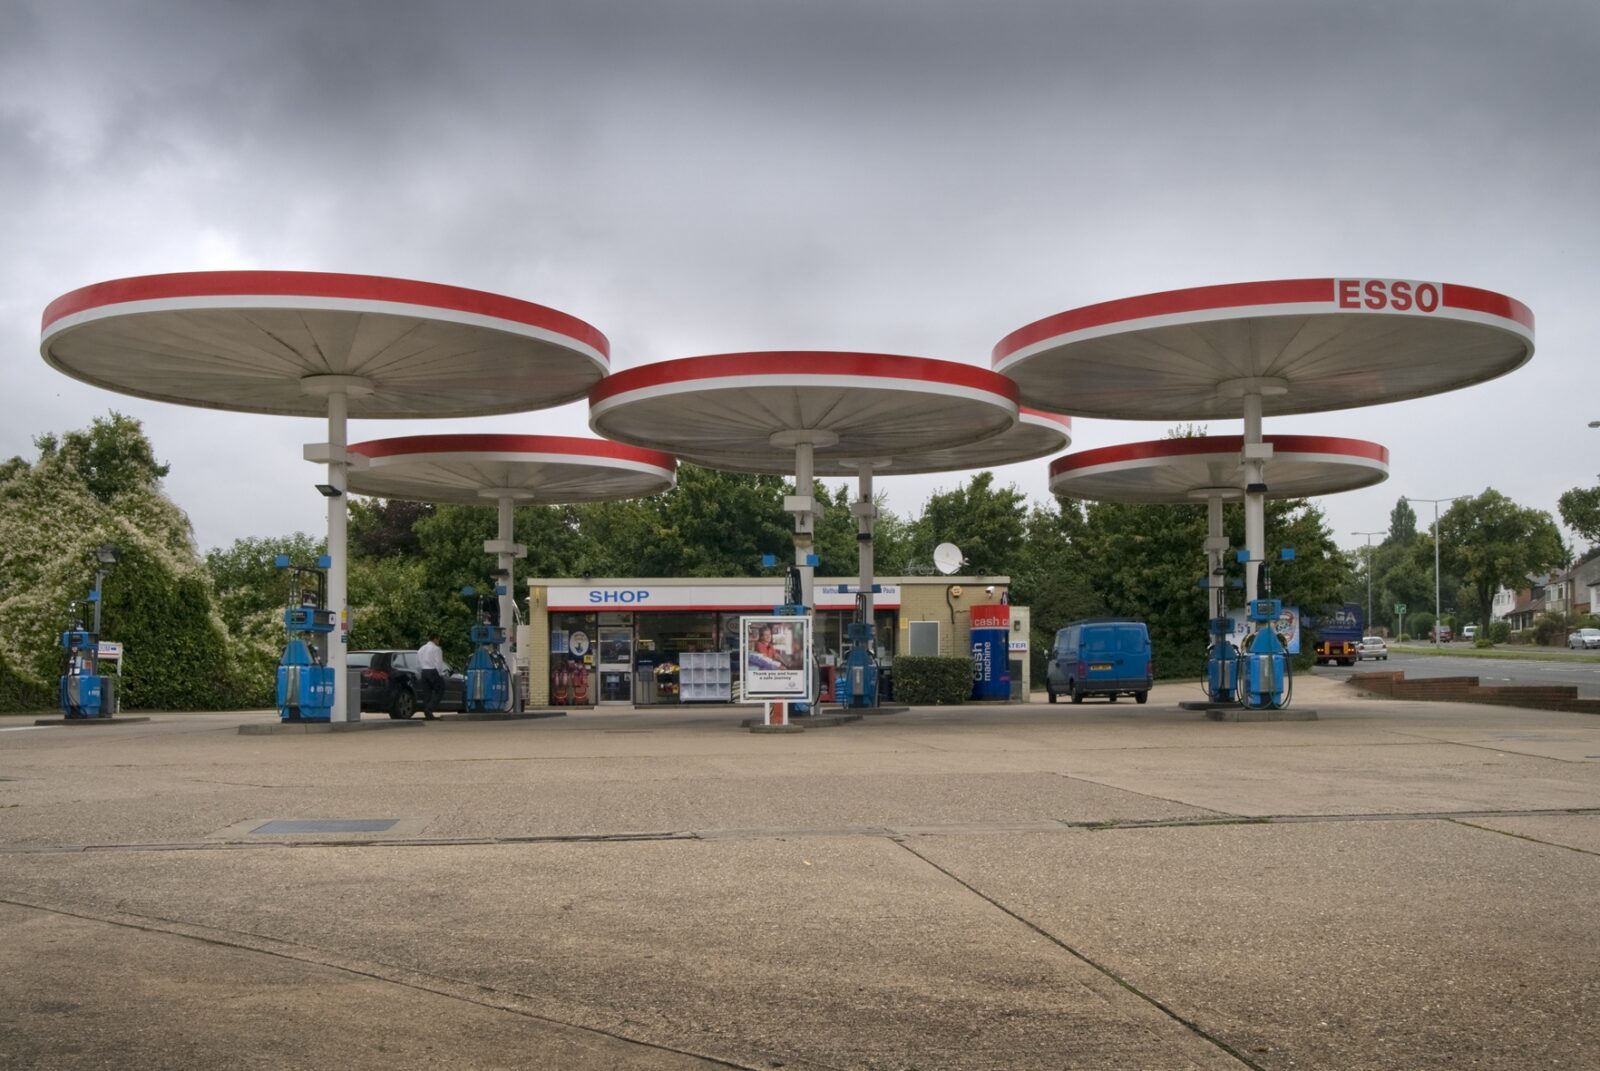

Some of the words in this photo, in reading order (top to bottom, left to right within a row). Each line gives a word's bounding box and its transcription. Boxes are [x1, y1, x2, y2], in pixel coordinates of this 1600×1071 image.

[1339, 280, 1439, 313] ESSO
[589, 590, 650, 603] SHOP
[974, 616, 1000, 627] cash
[972, 642, 983, 681] cash
[983, 641, 992, 681] machine
